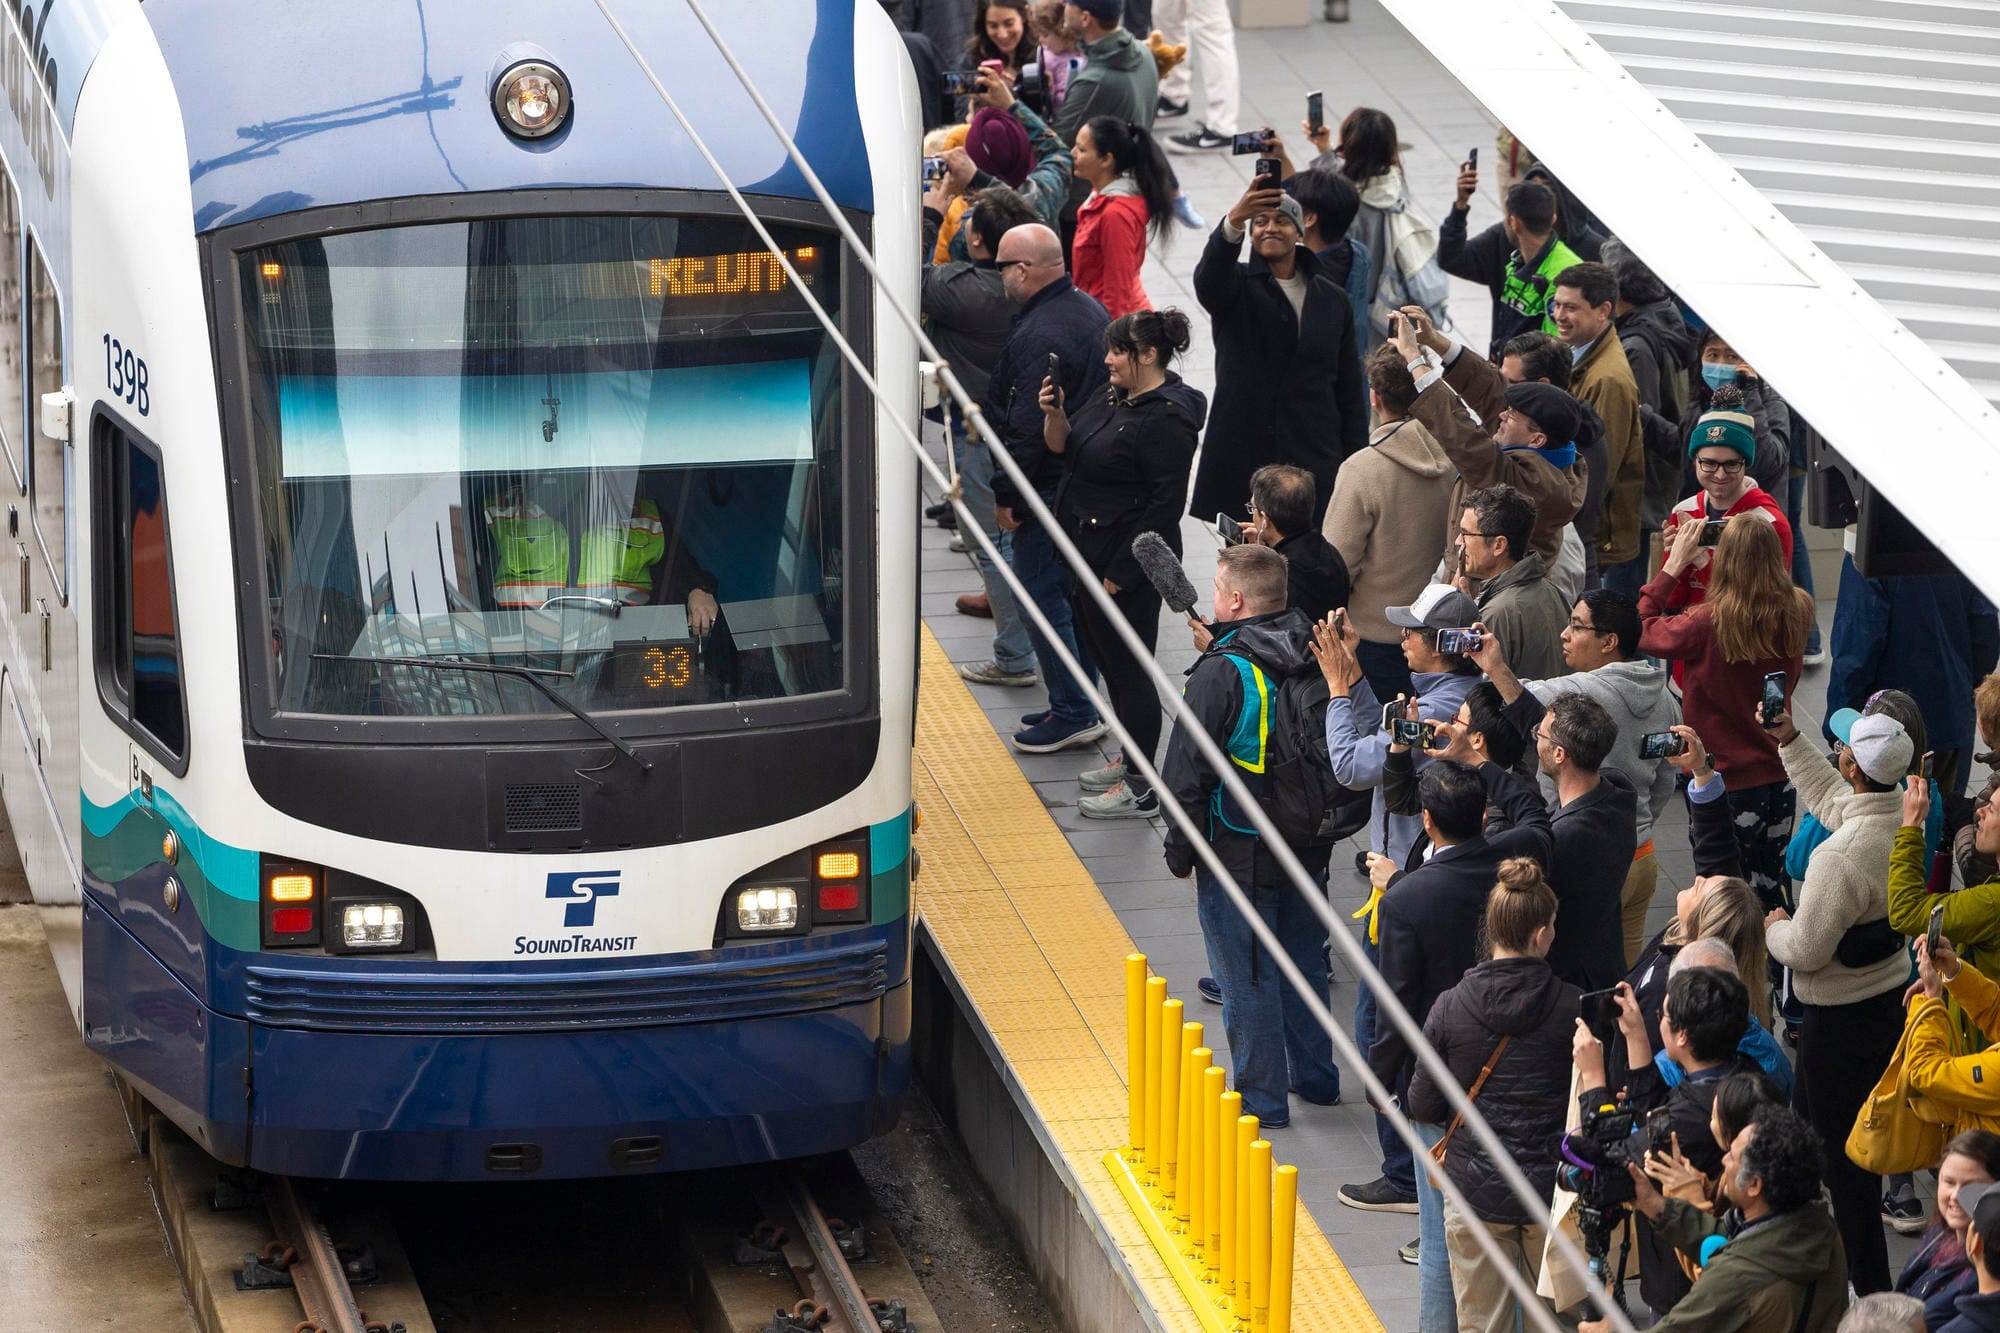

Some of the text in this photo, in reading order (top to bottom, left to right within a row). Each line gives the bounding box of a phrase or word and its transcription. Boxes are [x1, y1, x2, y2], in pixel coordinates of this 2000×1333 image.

[103, 333, 150, 417] 139B
[644, 646, 690, 689] 33
[133, 753, 139, 782] B
